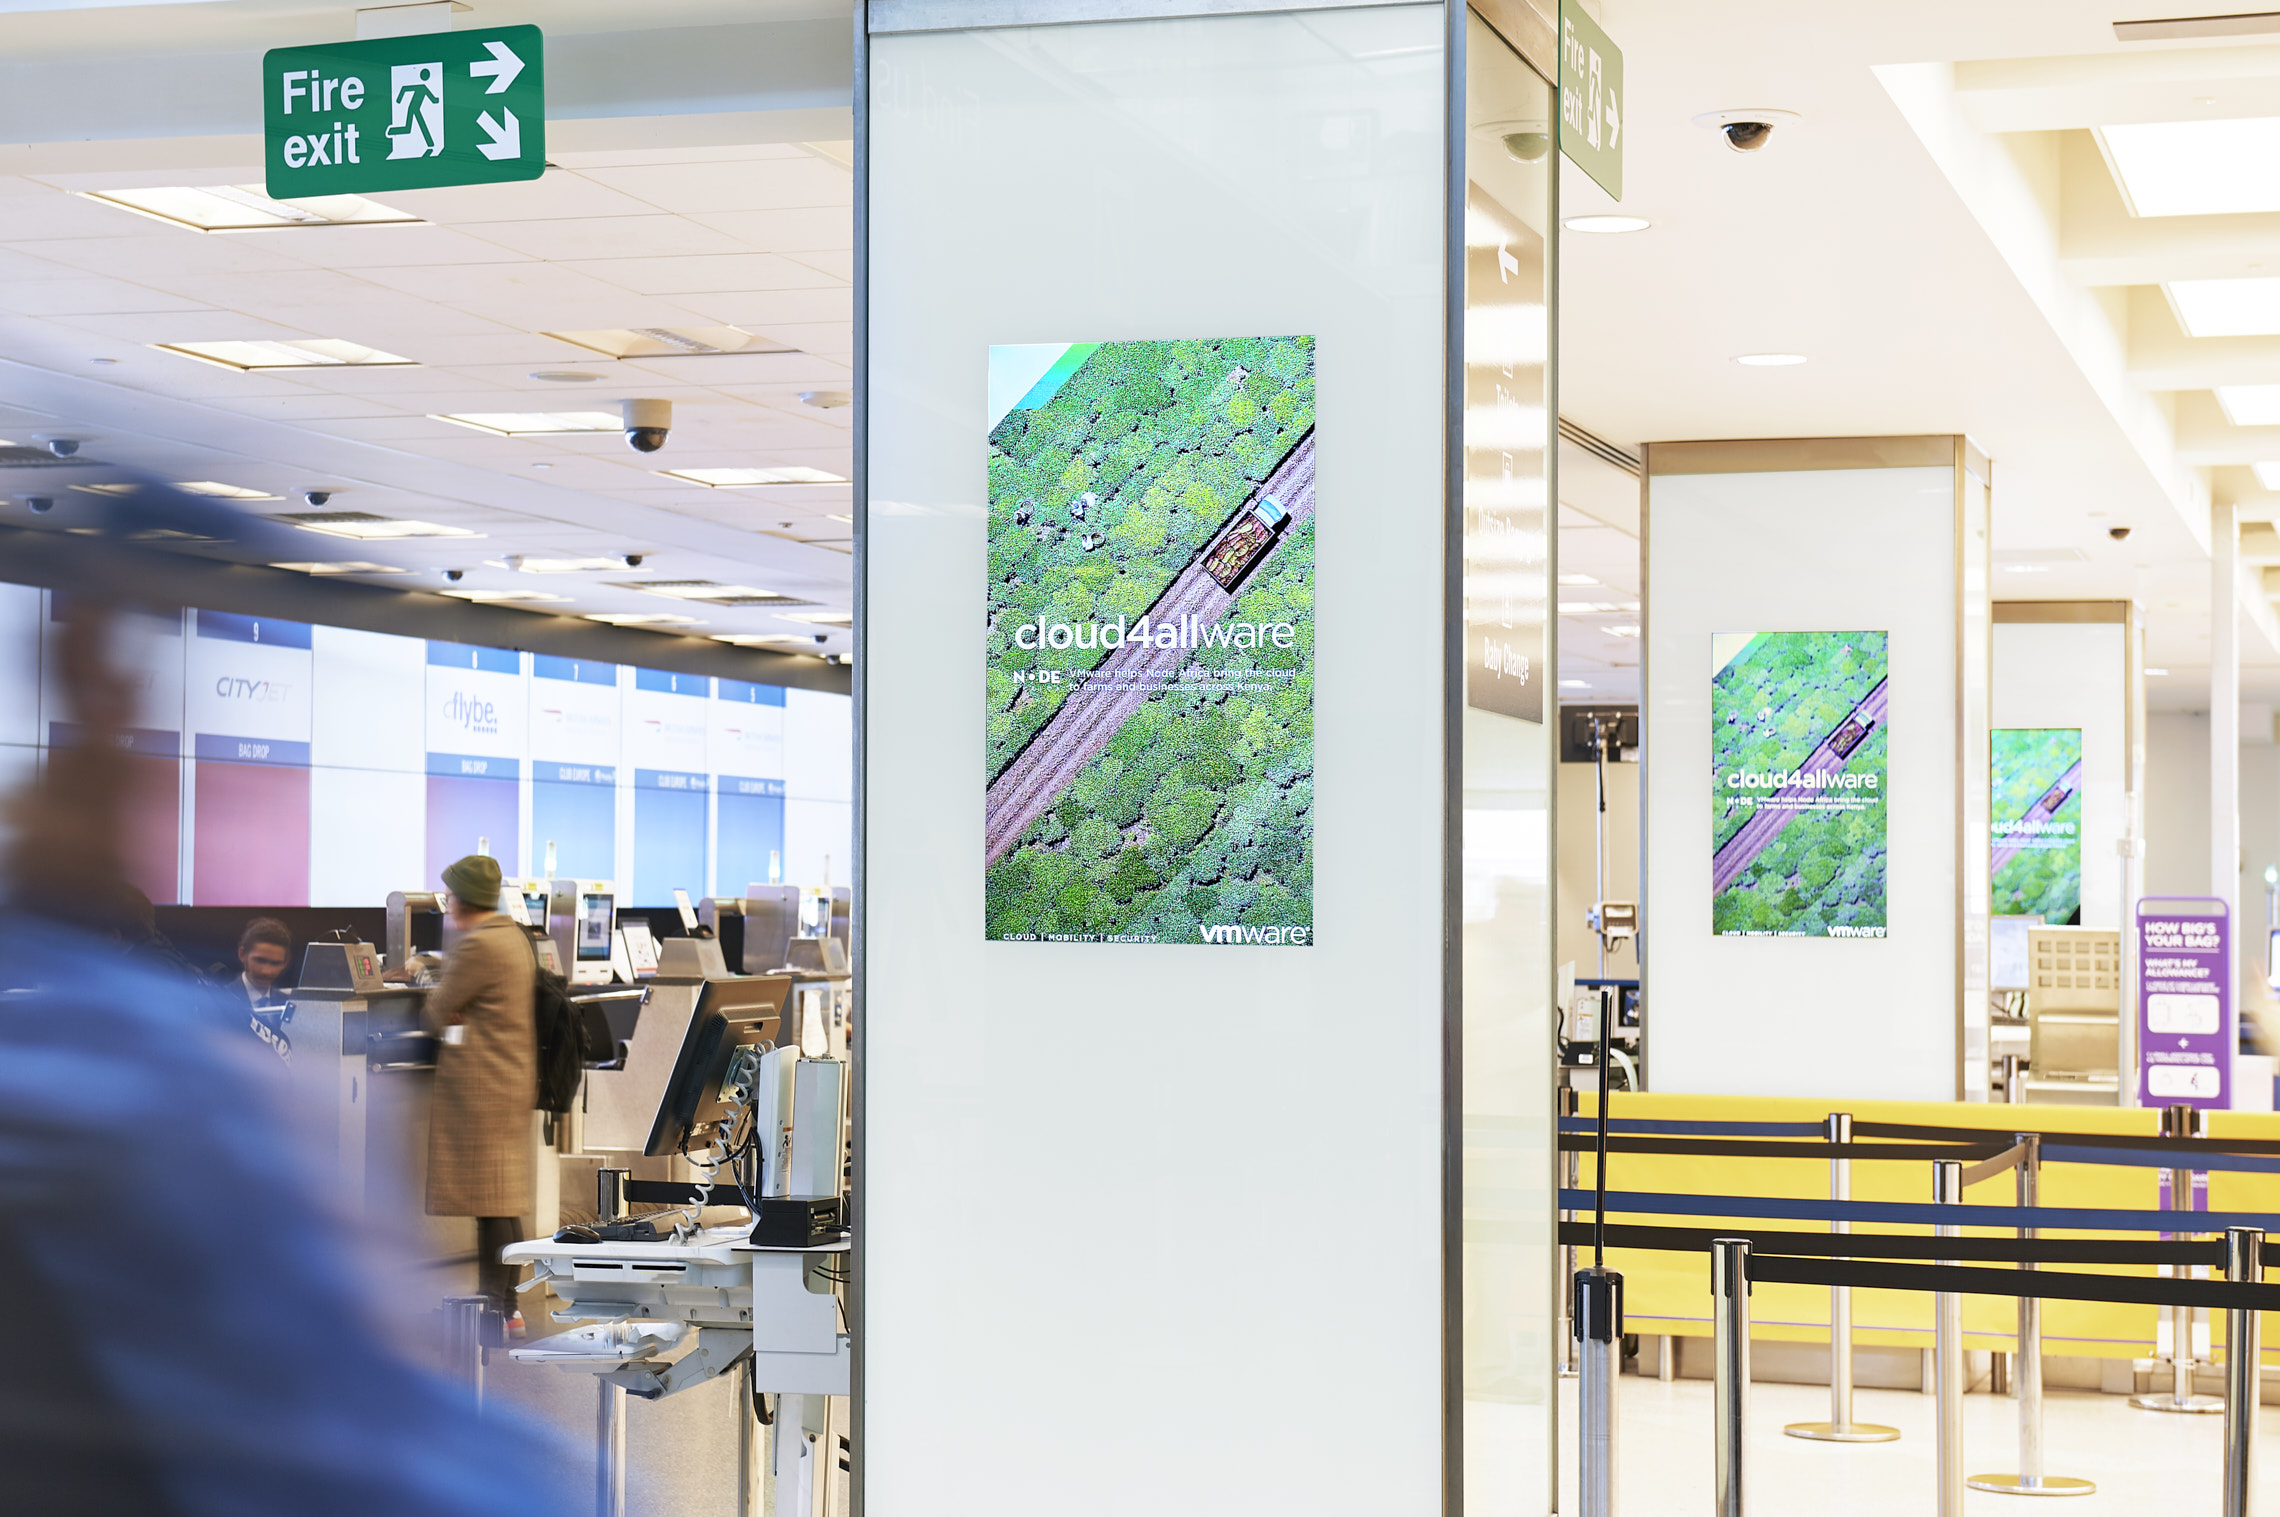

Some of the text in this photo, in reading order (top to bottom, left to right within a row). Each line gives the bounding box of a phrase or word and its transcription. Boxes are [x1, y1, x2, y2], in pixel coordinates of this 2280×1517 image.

[1564, 16, 1585, 79] Fire
[283, 69, 365, 115] Fire
[1563, 86, 1583, 136] exit
[283, 122, 360, 169] exit
[1496, 384, 1520, 410] Toil
[253, 622, 259, 642] 9
[1014, 613, 1295, 650] cloud4allware
[1484, 636, 1529, 687] Baby Change
[1069, 667, 1296, 680] VMware helps Node Africa bring the cloud
[216, 677, 293, 703] CITYJET
[1069, 682, 1080, 691] to
[1084, 682, 1113, 691] farms
[1115, 682, 1136, 691] and
[1139, 682, 1196, 691] businesses
[1199, 683, 1234, 691] across
[238, 743, 270, 760] BAG DROP
[1727, 769, 1878, 789] cloud4allware
[1991, 818, 2075, 835] ud4allware
[1003, 933, 1157, 943] CLOUD MOBILITY SECURITY
[1200, 924, 1310, 945] vmware
[1827, 925, 1886, 938] vmware
[2144, 922, 2217, 936] HOW BIG'S
[2144, 934, 2221, 949] YOUR BAG?
[2144, 957, 2181, 969] WHAT'S
